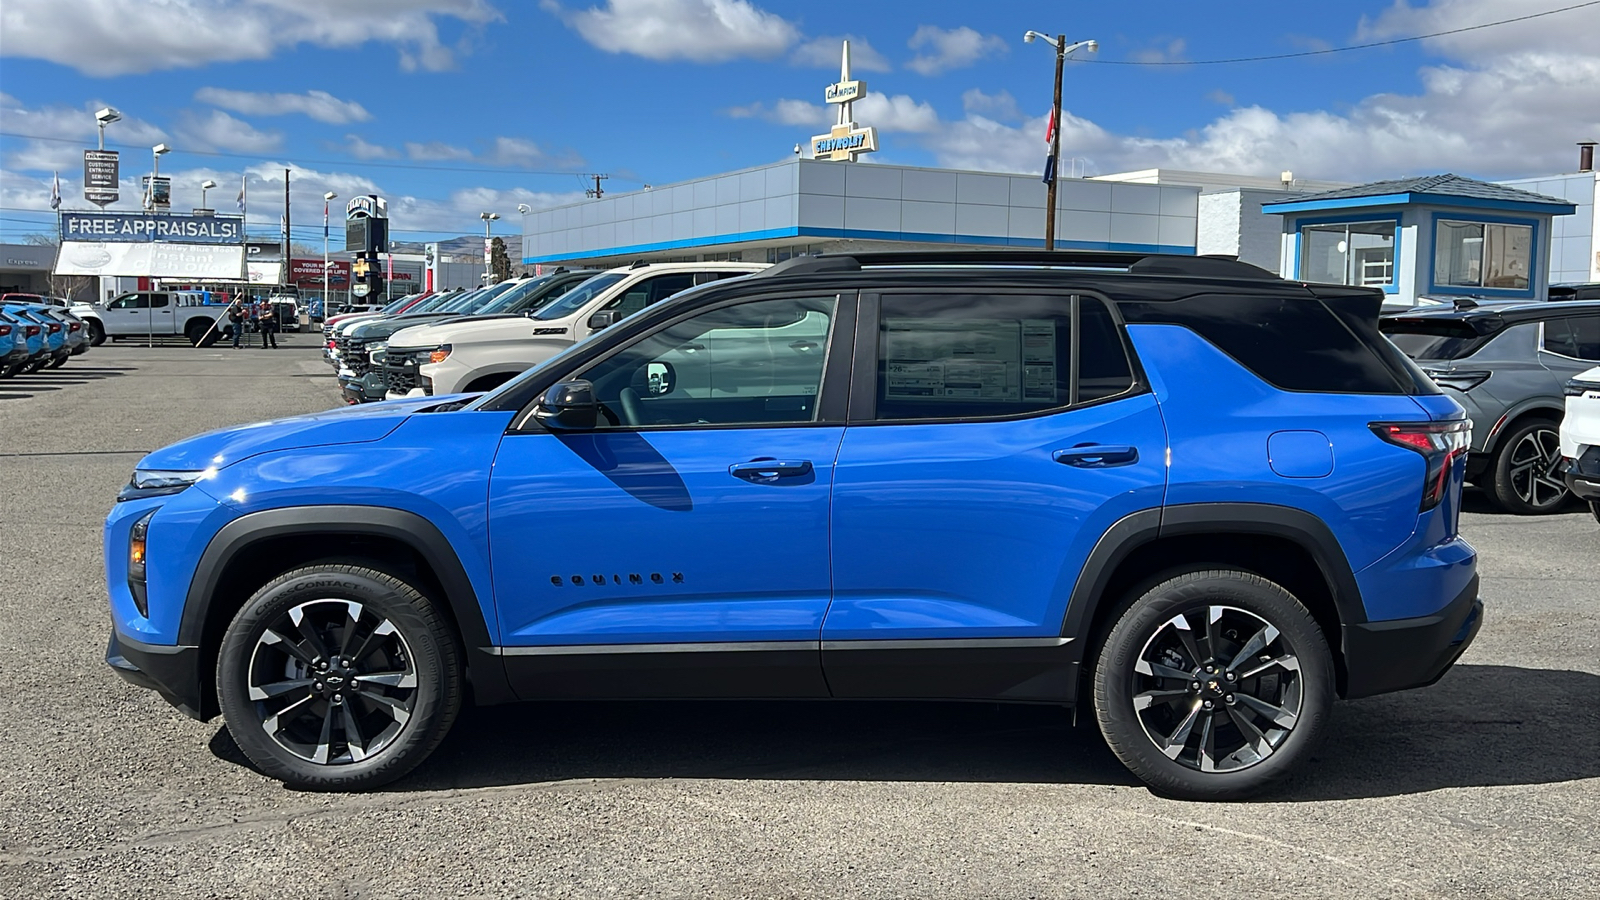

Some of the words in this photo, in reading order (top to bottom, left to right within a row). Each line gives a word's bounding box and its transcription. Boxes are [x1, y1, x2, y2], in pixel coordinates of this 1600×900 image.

[827, 85, 857, 99] CHAMPION
[816, 134, 865, 152] CHEVROLET
[68, 219, 116, 234] FREE
[121, 221, 237, 238] APPRAISALS!
[159, 244, 187, 252] Kelley
[152, 250, 214, 262] Instant
[550, 572, 685, 587] EQUINOX
